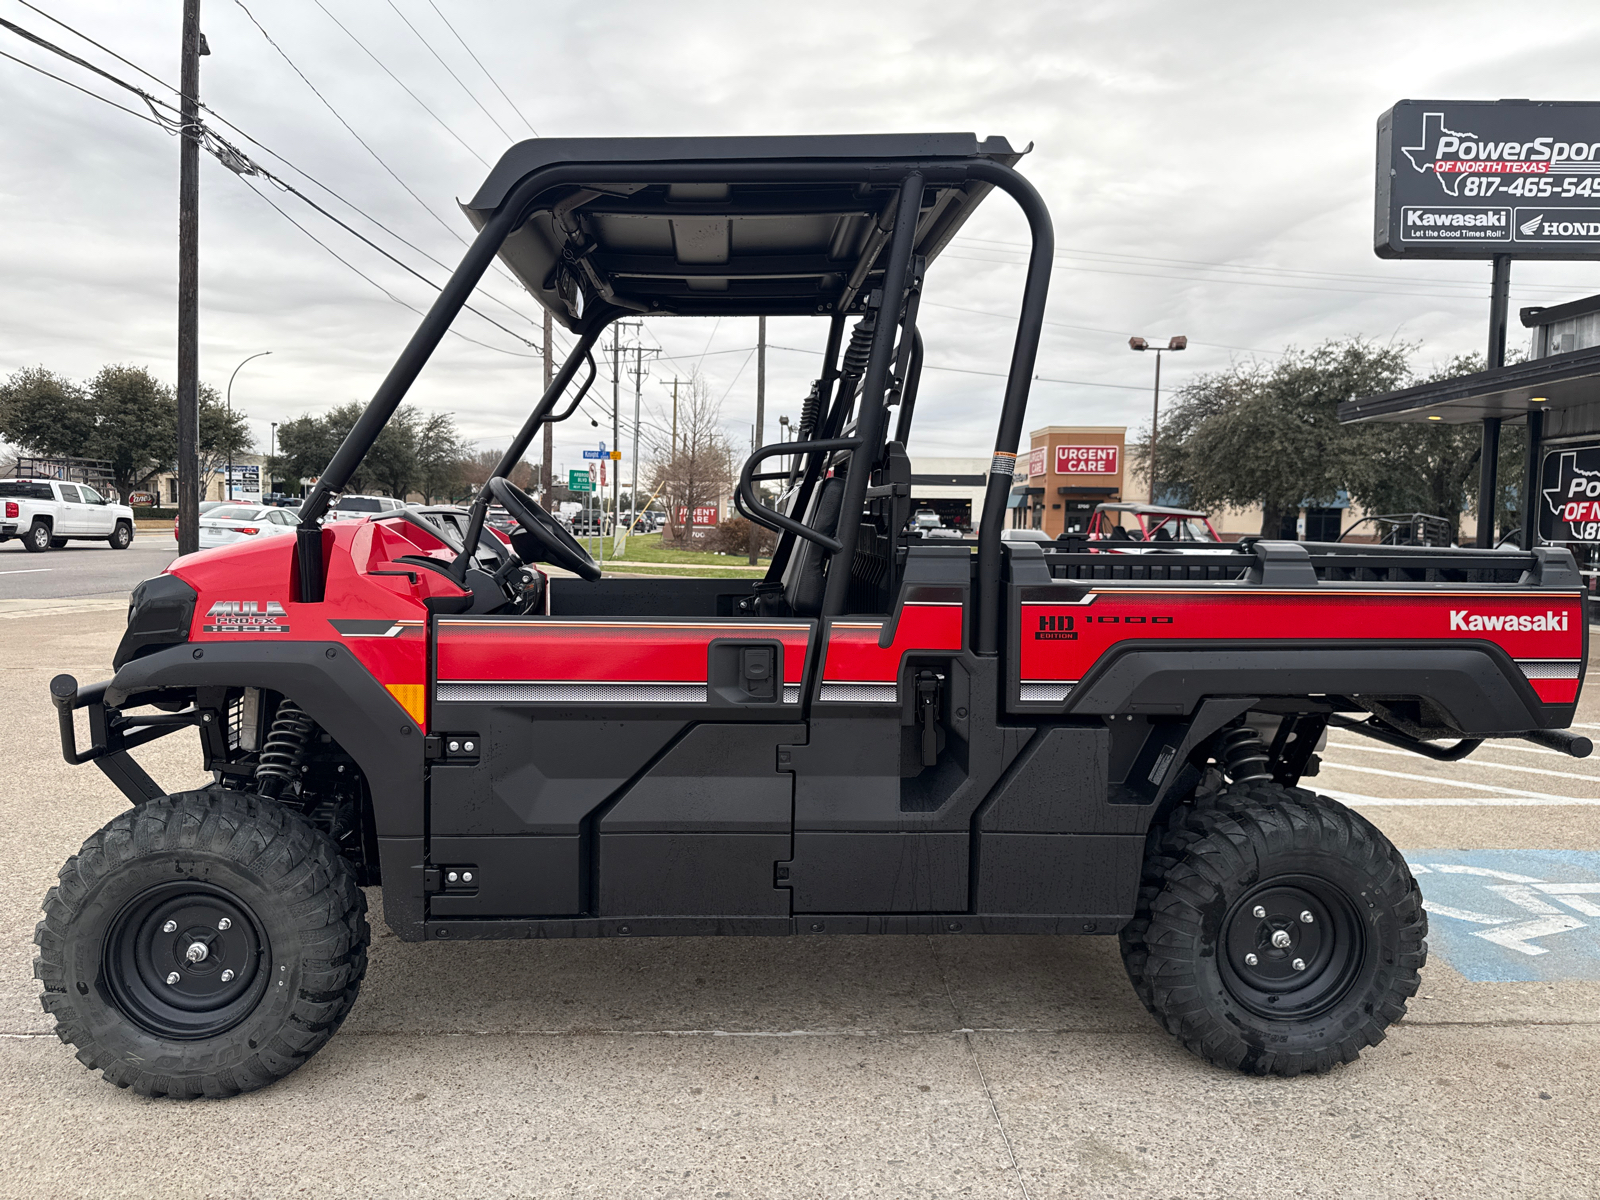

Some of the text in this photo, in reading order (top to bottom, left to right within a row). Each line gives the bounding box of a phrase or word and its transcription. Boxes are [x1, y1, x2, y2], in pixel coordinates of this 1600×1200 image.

[1435, 161, 1547, 173] OF NORTH TEXAS
[1407, 210, 1506, 226] Kawasaki
[1411, 229, 1425, 238] Let
[1426, 229, 1438, 238] the
[1439, 229, 1460, 238] Good
[1461, 229, 1485, 238] Times
[1059, 448, 1116, 460] URGENT
[1068, 460, 1106, 472] CARE
[1564, 502, 1590, 520] OF
[205, 600, 289, 618] MULE
[1039, 615, 1174, 631] HD 1000
[1449, 610, 1569, 632] Kawasaki
